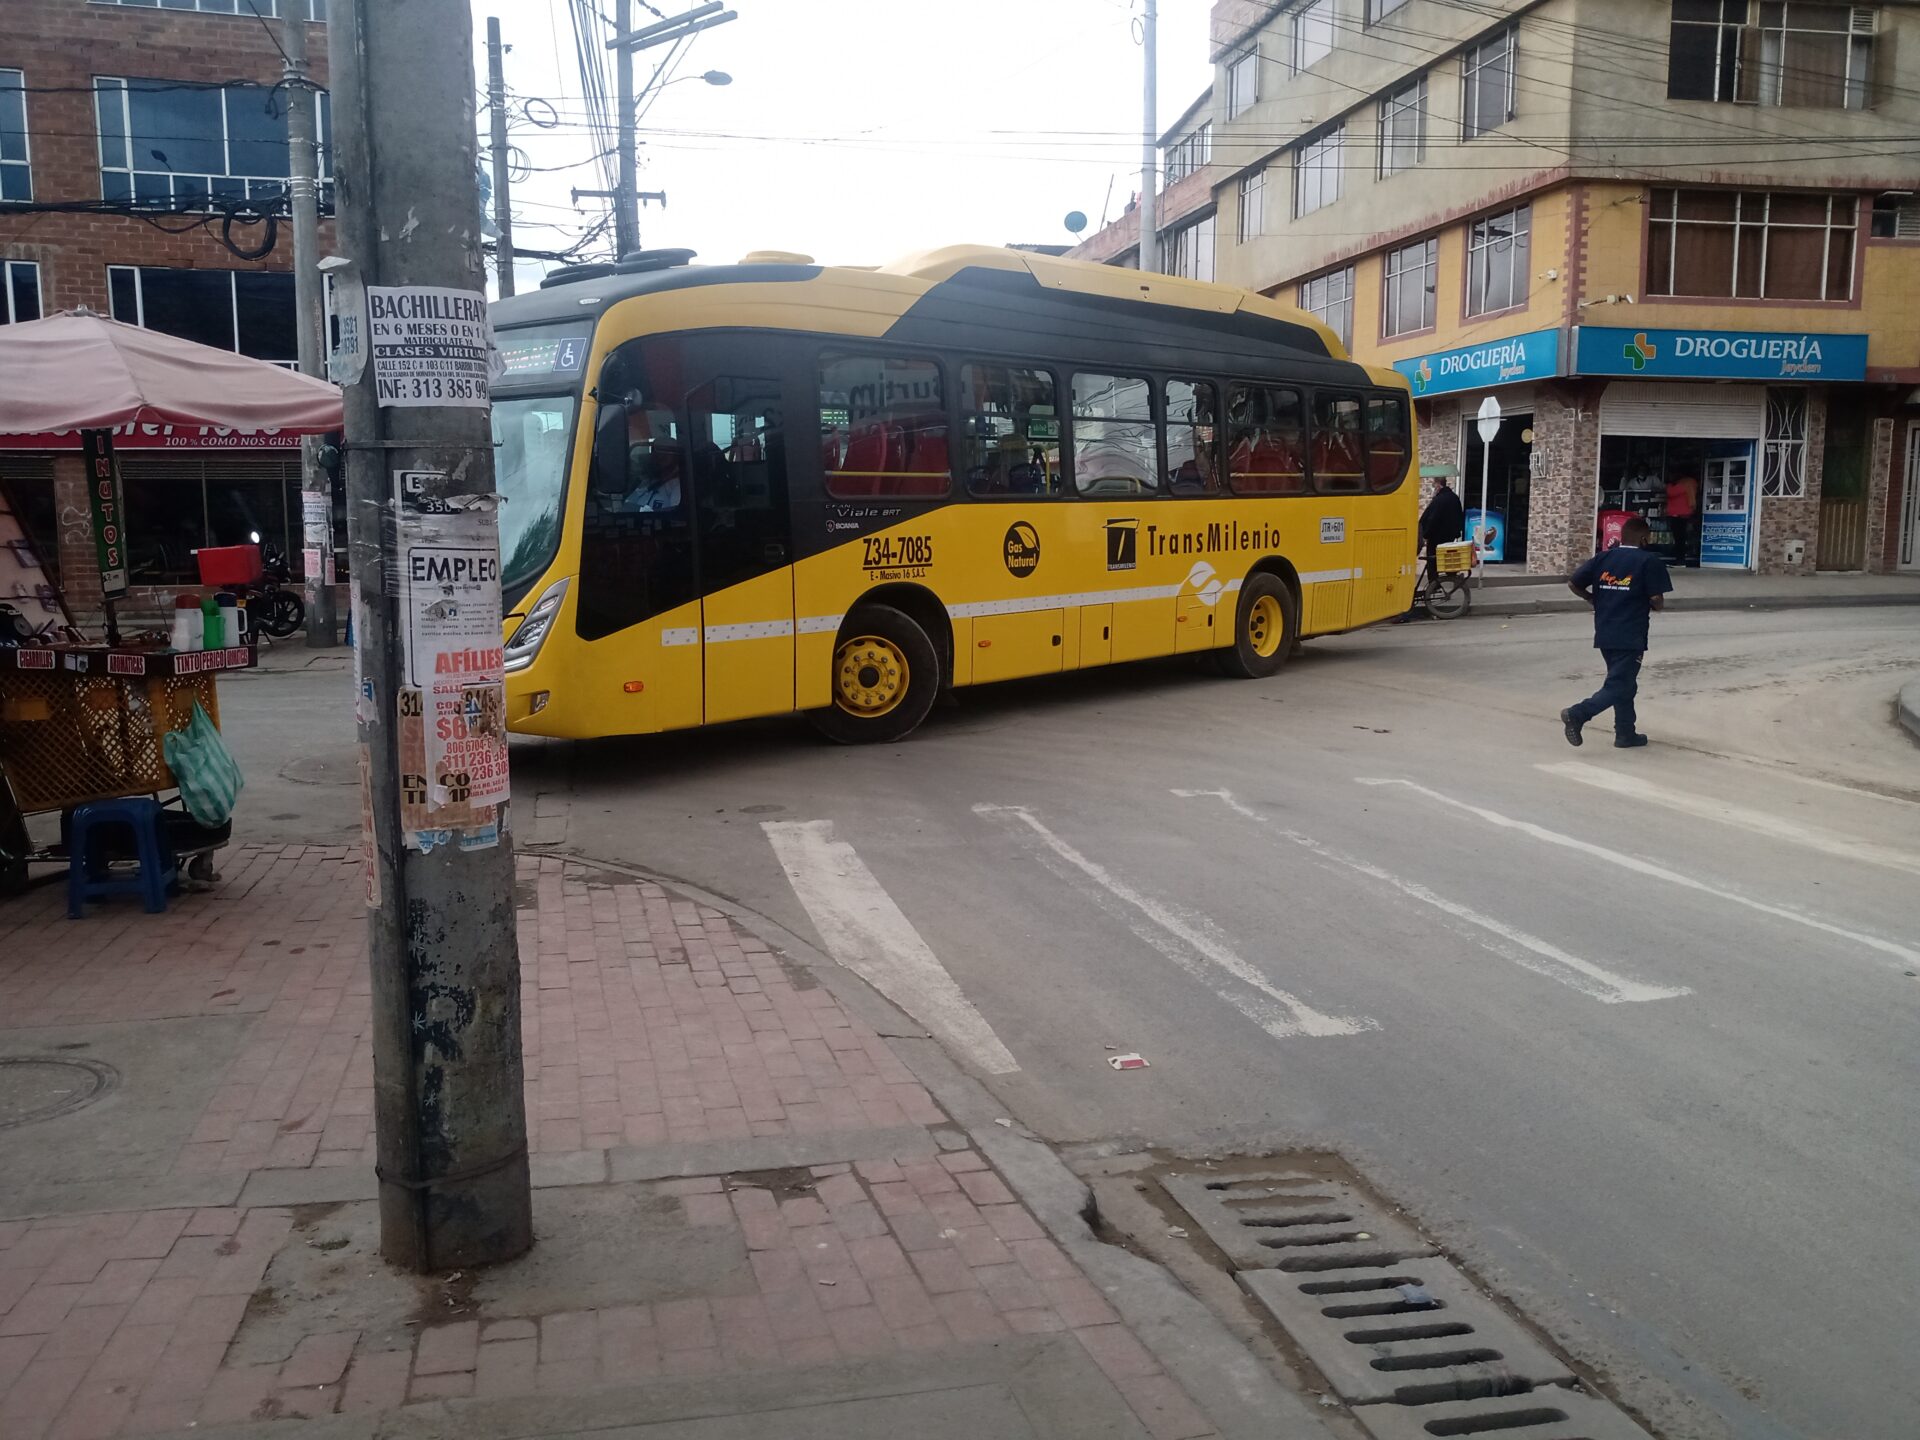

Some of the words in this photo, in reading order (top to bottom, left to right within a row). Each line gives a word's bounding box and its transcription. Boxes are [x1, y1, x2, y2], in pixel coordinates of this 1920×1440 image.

[370, 295, 486, 322] BACHILLERAT
[373, 323, 391, 336] EN
[394, 324, 403, 336] 6
[407, 323, 447, 336] MESES
[462, 326, 474, 338] EN
[403, 336, 463, 346] MATRICULATE
[463, 338, 474, 346] YA
[1674, 336, 1823, 361] DROGUERÍA
[375, 346, 434, 357] CLASES
[1440, 339, 1526, 376] DROGUERÍA
[377, 360, 396, 371] CALLE
[399, 360, 411, 371] 152
[426, 361, 439, 371] 103
[379, 378, 407, 399] INF:
[411, 378, 442, 398] 313
[447, 378, 472, 399] 385
[165, 436, 188, 447] 100
[200, 436, 238, 447] COMO
[240, 436, 266, 447] NOS
[96, 434, 120, 568] INUTOS
[837, 507, 879, 517] Viale
[882, 508, 902, 516] BRT
[1007, 540, 1023, 554] Gas
[1147, 520, 1281, 556] TransMilenio
[862, 535, 933, 566] Z34-7085
[411, 556, 497, 582] EMPLEO
[1007, 553, 1037, 569] Natural
[879, 570, 902, 580] Masivo
[902, 569, 911, 579] 16
[109, 654, 144, 674] AROMATICAS
[175, 653, 200, 674] TINTO
[434, 647, 504, 674] AFÍLIES
[433, 684, 464, 695] SALU
[436, 717, 468, 742] $6
[469, 749, 492, 767] 236
[471, 764, 494, 781] 236
